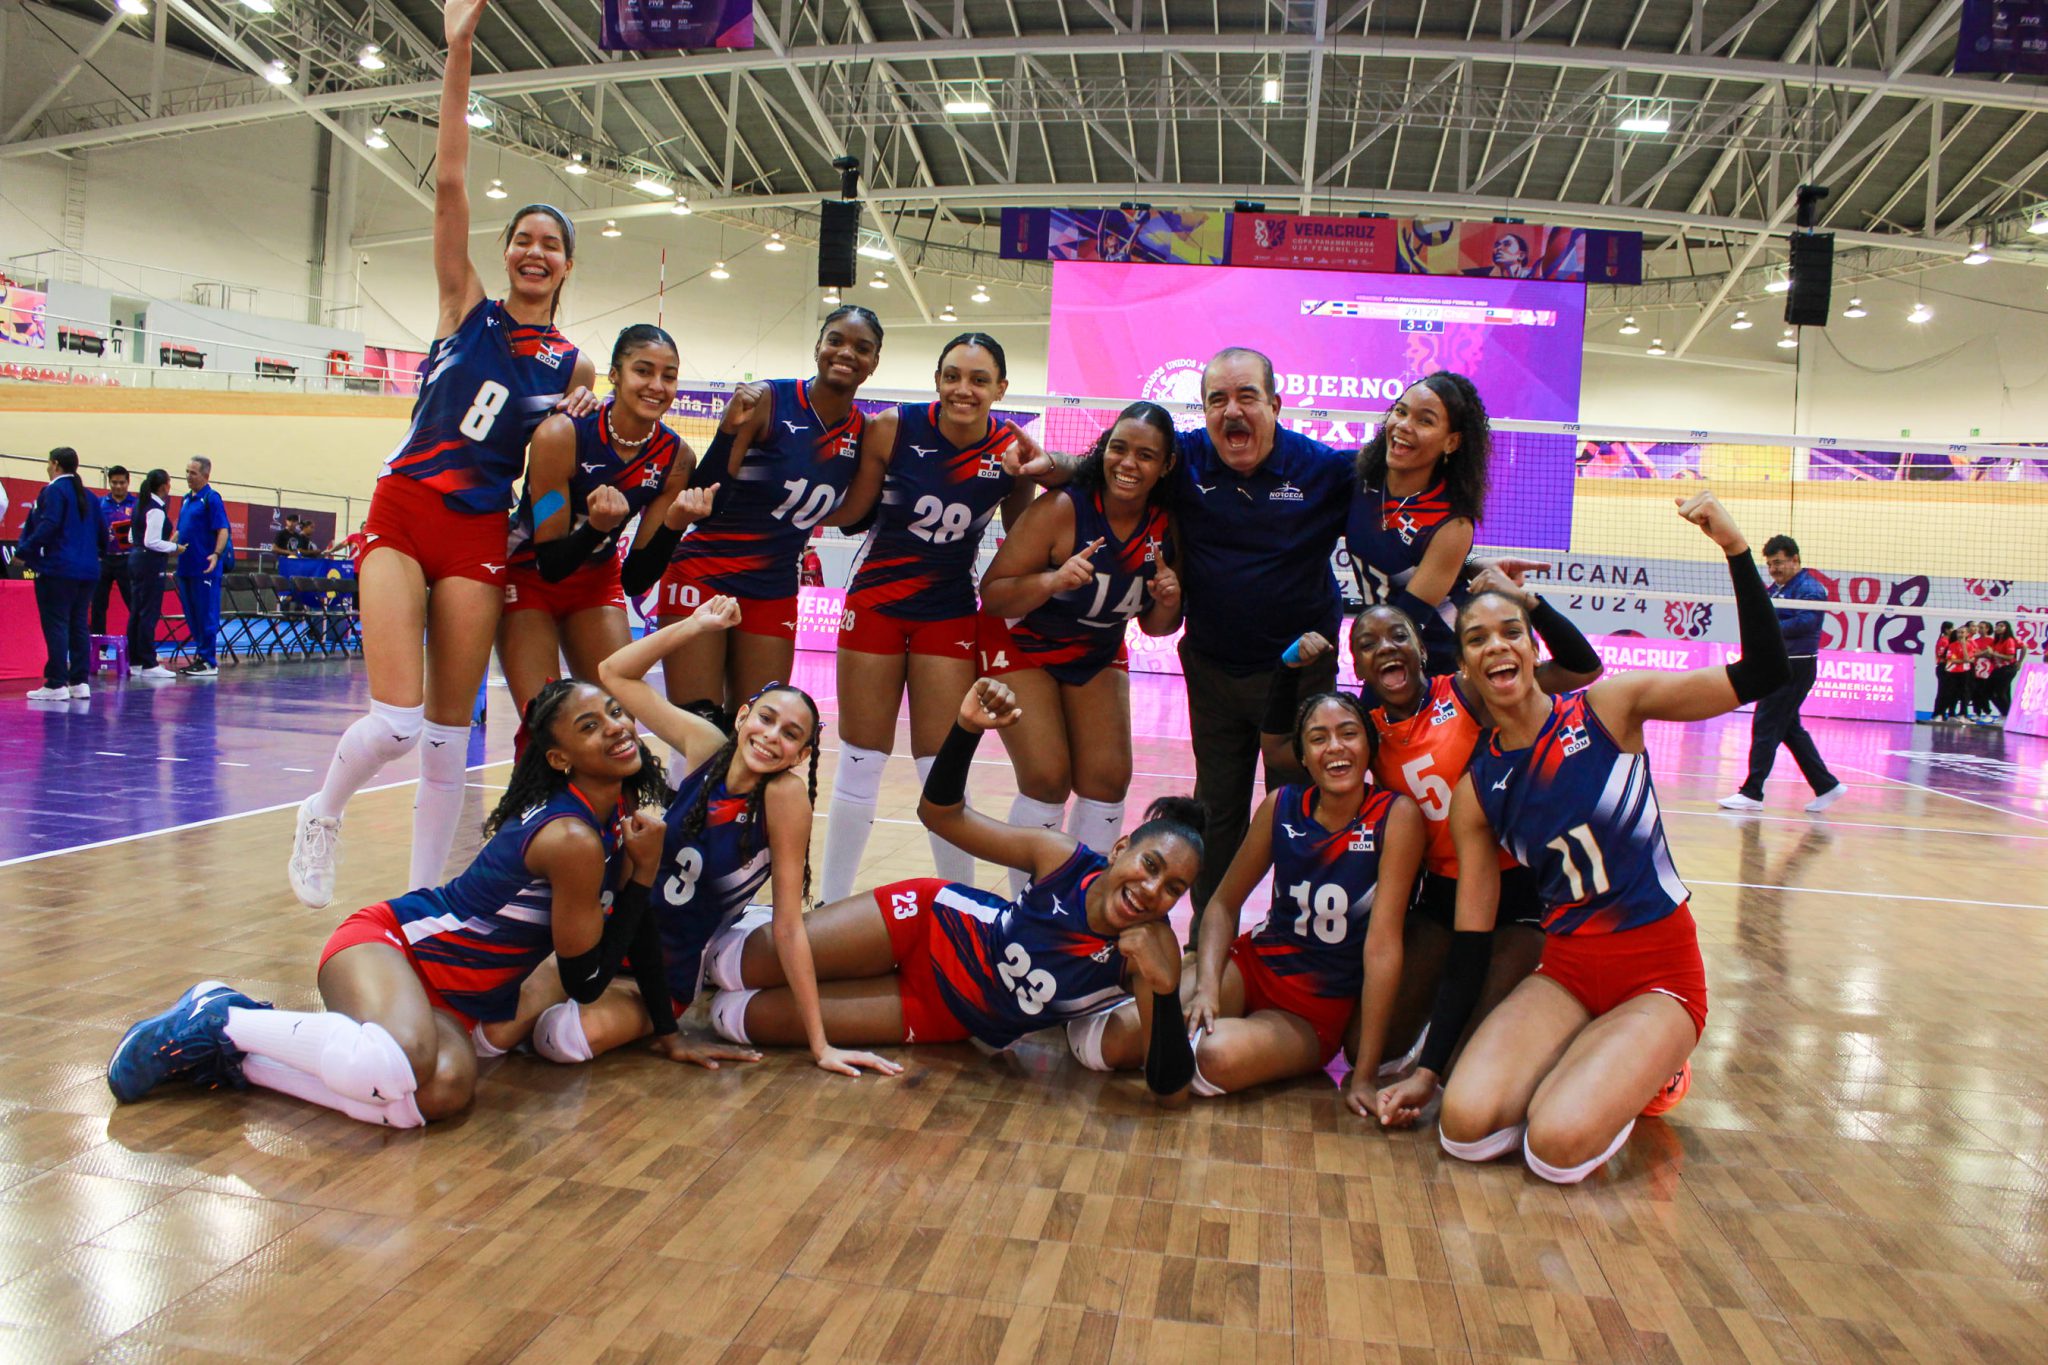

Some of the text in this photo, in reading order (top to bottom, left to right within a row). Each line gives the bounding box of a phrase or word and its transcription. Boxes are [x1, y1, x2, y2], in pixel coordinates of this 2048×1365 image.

[1294, 223, 1376, 239] VERACRUZ
[539, 353, 558, 368] DOM
[1141, 366, 1166, 399] ESTADOS
[1165, 359, 1197, 371] UNIDOS
[458, 379, 510, 442] 8
[1310, 409, 1328, 417] FIVB
[1562, 423, 1580, 431] FIVB
[1690, 430, 1708, 438] FIVB
[1818, 437, 1837, 445] FIVB
[1949, 444, 1967, 452] FIVB
[842, 449, 855, 457] DOM
[981, 470, 998, 478] DOM
[771, 478, 836, 530] 10
[1269, 491, 1304, 499] NORCECA
[907, 494, 972, 544] 28
[667, 582, 700, 608] 10
[1077, 572, 1144, 628] 14
[1570, 594, 1648, 613] 2024
[840, 608, 856, 632] 28
[980, 650, 1010, 672] 14
[1813, 681, 1894, 693] ANAMERICANA
[1865, 693, 1894, 702] 2024
[1435, 710, 1454, 724] DOM
[1567, 739, 1588, 753] DOM
[1401, 753, 1453, 822] 5
[1545, 823, 1610, 901] 11
[663, 846, 704, 906] 3
[891, 890, 919, 921] 23
[1289, 880, 1349, 945] 18
[996, 942, 1057, 1016] 23
